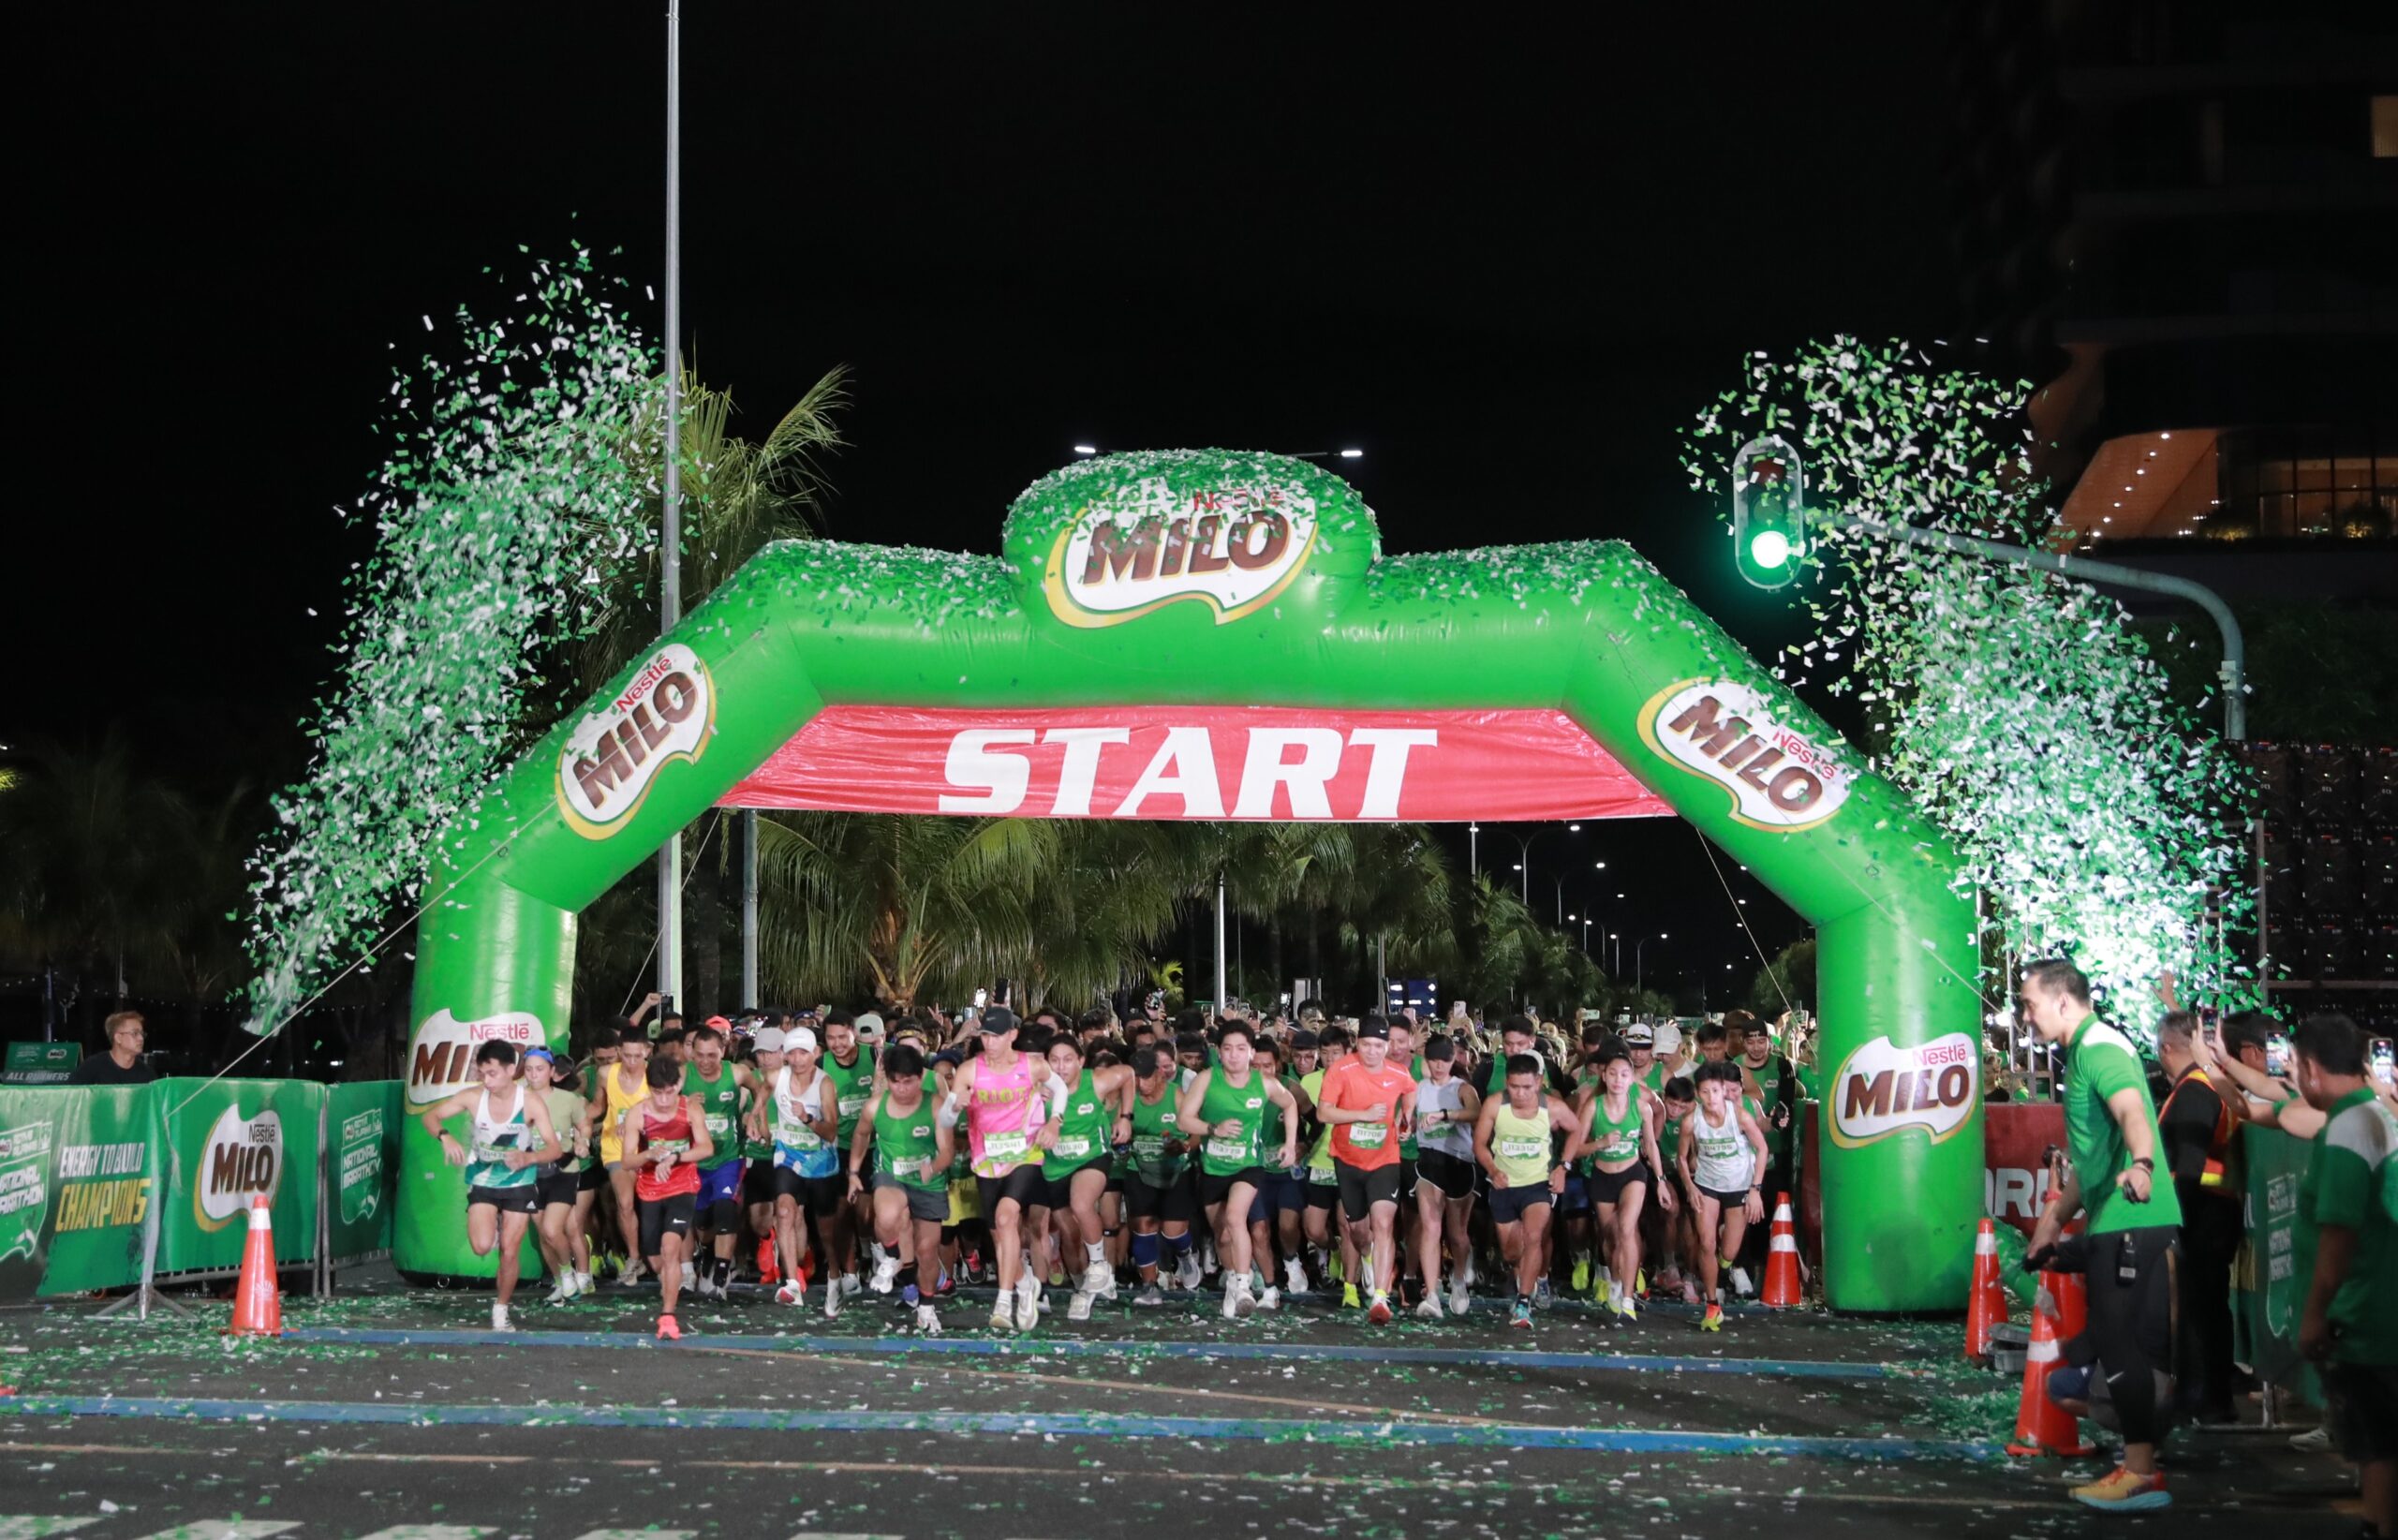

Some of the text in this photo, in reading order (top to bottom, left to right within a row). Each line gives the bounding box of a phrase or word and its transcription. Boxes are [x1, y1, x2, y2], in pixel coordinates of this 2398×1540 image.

[1083, 510, 1289, 585] MILO
[572, 672, 699, 809] MILO
[1668, 695, 1823, 811] MILO
[1772, 731, 1837, 779] Nesté
[939, 726, 1438, 819] START
[1844, 1065, 1970, 1119] MILO
[0, 1165, 40, 1194] ATIONAL
[59, 1142, 145, 1178] ENERGY TO BUILD
[211, 1143, 274, 1194] MILO
[0, 1183, 44, 1215] ARATHON
[55, 1178, 152, 1232] CHAMPIONS
